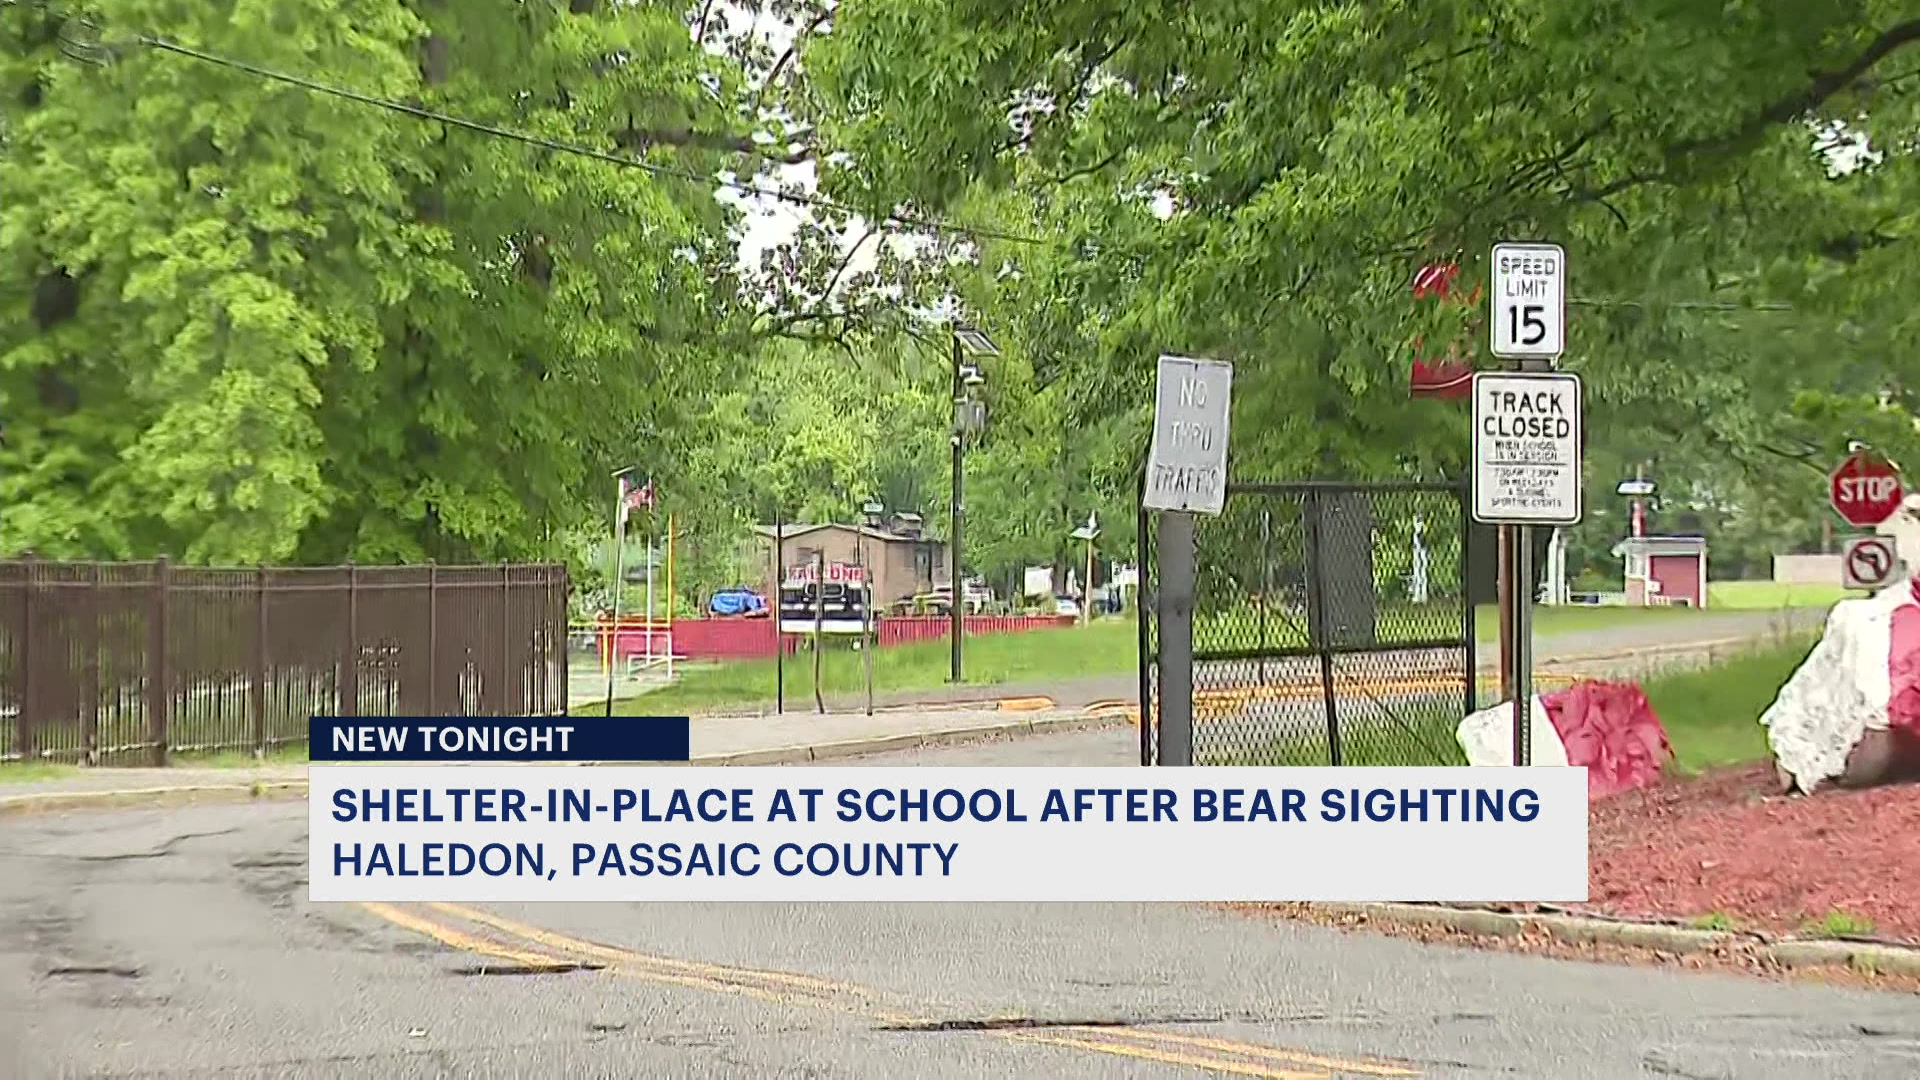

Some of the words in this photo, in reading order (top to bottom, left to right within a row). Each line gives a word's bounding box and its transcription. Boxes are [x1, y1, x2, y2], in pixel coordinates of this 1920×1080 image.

[1500, 256, 1555, 275] SPEED
[1506, 279, 1548, 298] LIMIT
[1509, 304, 1546, 345] 15
[1179, 376, 1208, 407] NO
[1490, 391, 1563, 414] TRACK
[1484, 416, 1570, 438] CLOSED
[1839, 477, 1898, 502] STOP
